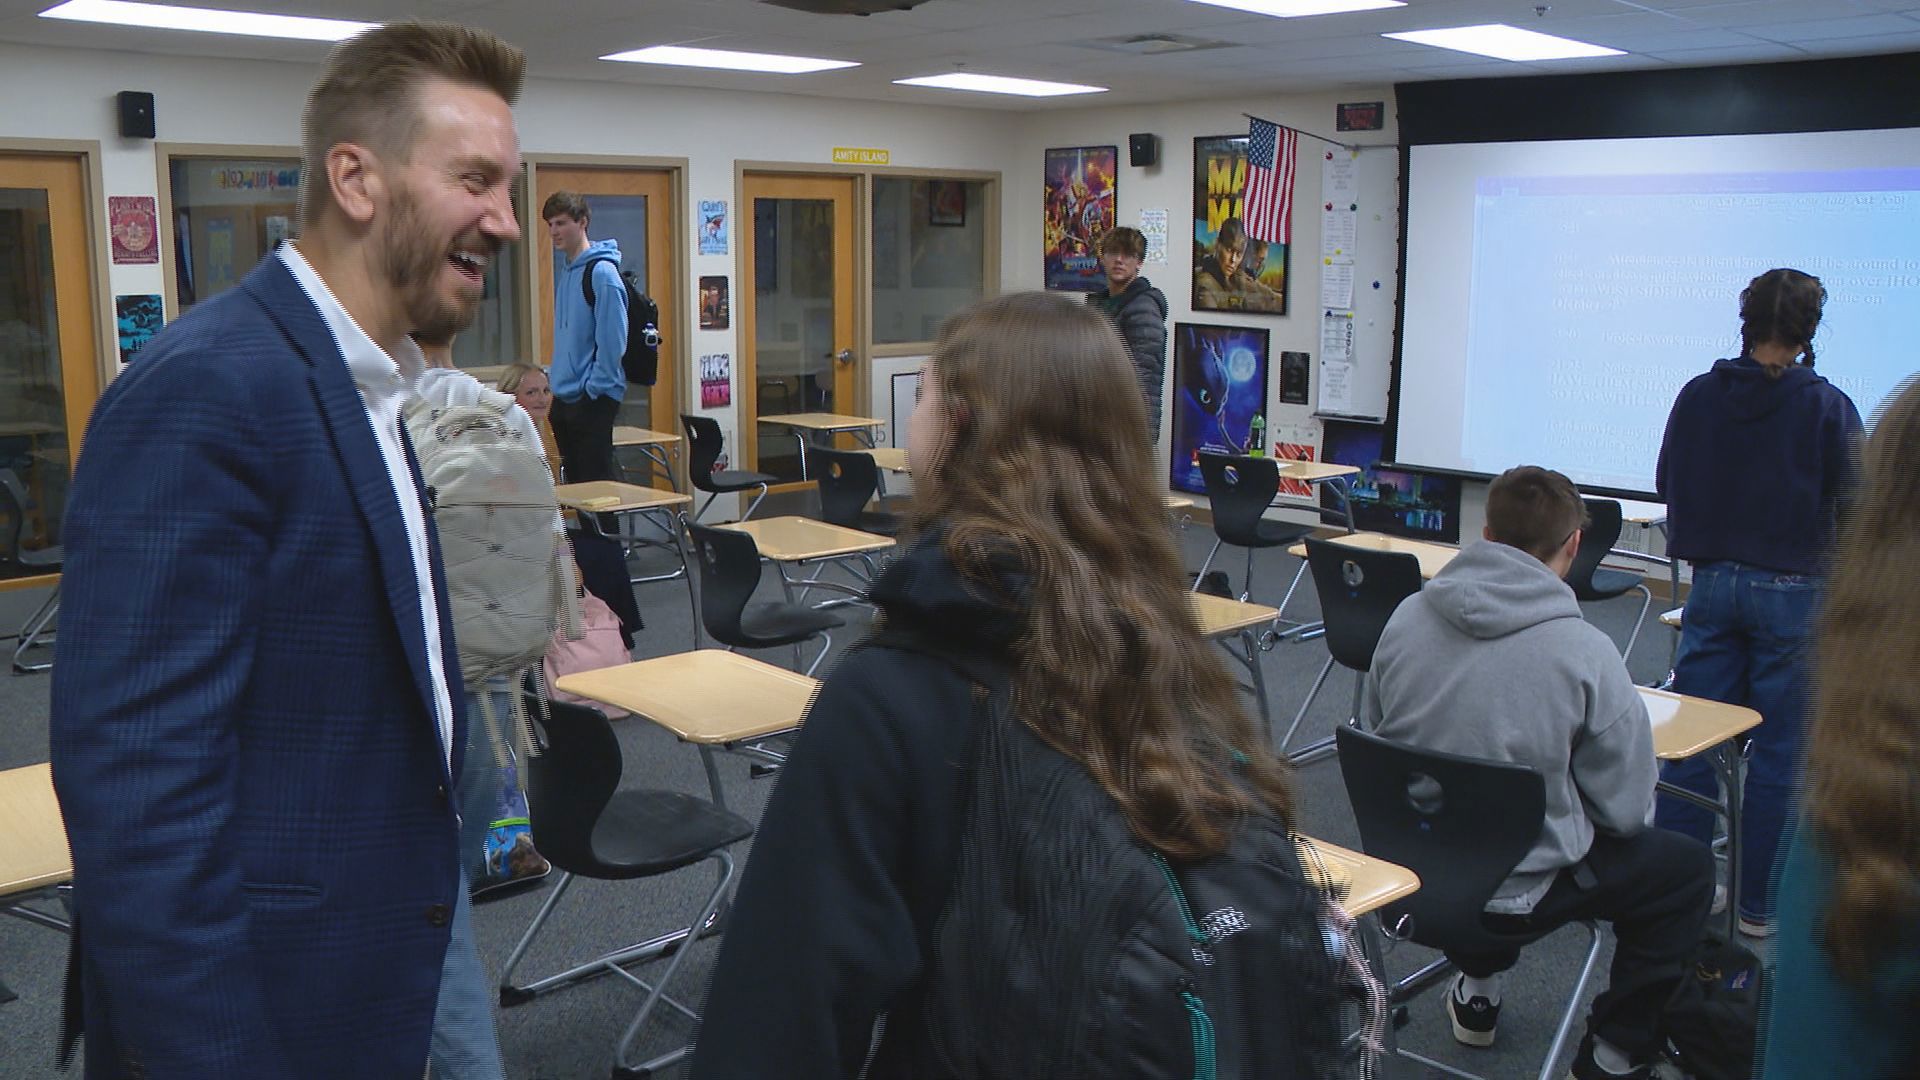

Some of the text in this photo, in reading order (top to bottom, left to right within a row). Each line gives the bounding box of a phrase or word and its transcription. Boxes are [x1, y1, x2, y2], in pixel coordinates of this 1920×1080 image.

[834, 150, 888, 163] AMITY ISLAND
[1207, 156, 1249, 194] MA
[1826, 257, 1845, 269] be
[1848, 258, 1899, 271] around
[1904, 259, 1920, 271] to
[1887, 275, 1920, 288] IHO
[1864, 295, 1883, 305] on
